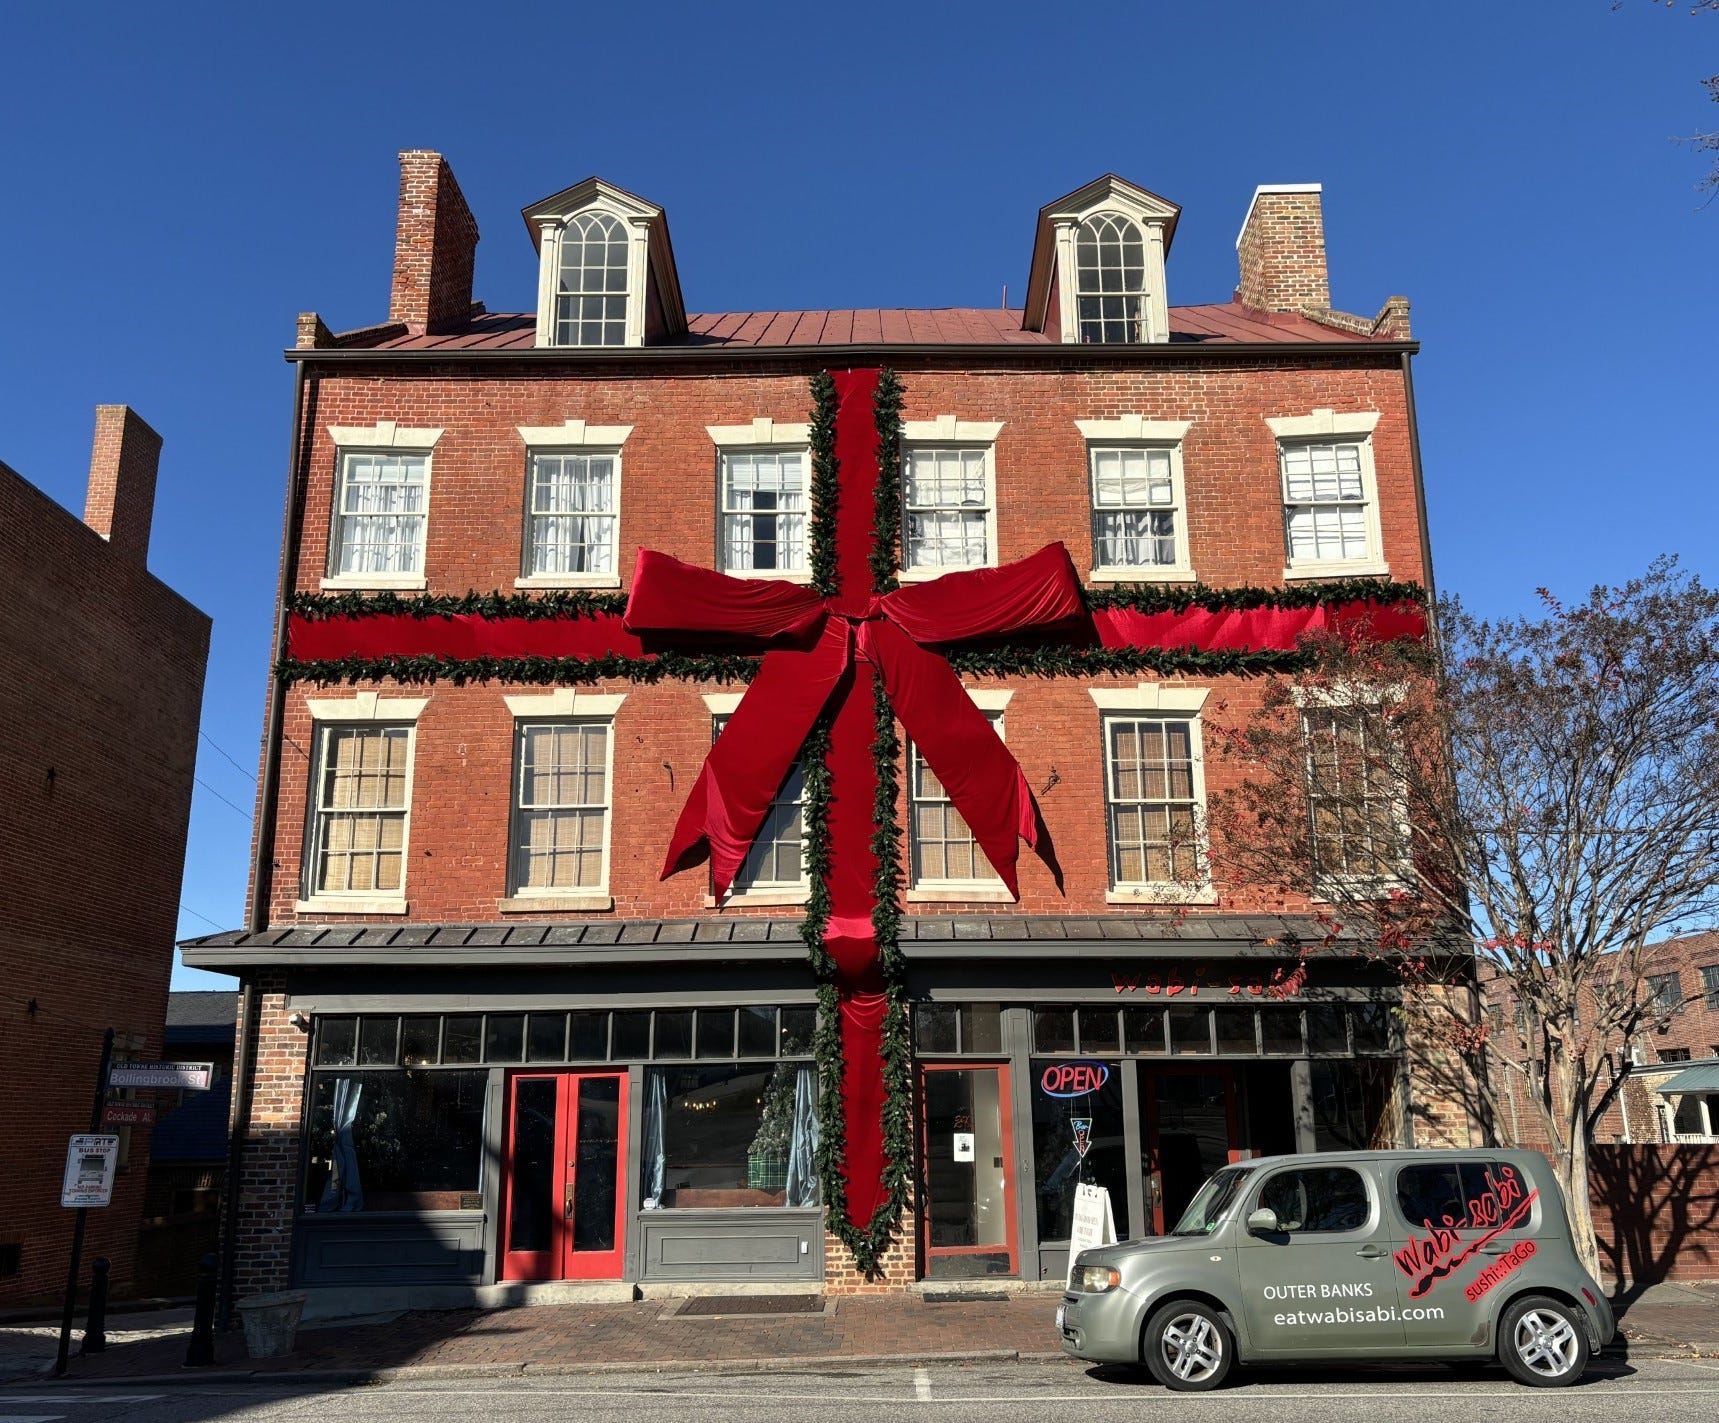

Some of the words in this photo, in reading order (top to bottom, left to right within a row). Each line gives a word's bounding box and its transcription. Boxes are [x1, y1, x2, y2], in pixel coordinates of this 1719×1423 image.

[110, 1073, 184, 1085] Bollingbrook
[187, 1074, 205, 1085] St.
[1043, 1066, 1102, 1091] OPEN
[107, 1110, 137, 1121] Cockade
[1263, 1284, 1317, 1300] OUTER
[1321, 1282, 1373, 1298] BANKS
[1274, 1306, 1445, 1325] eatwabisabi.com
